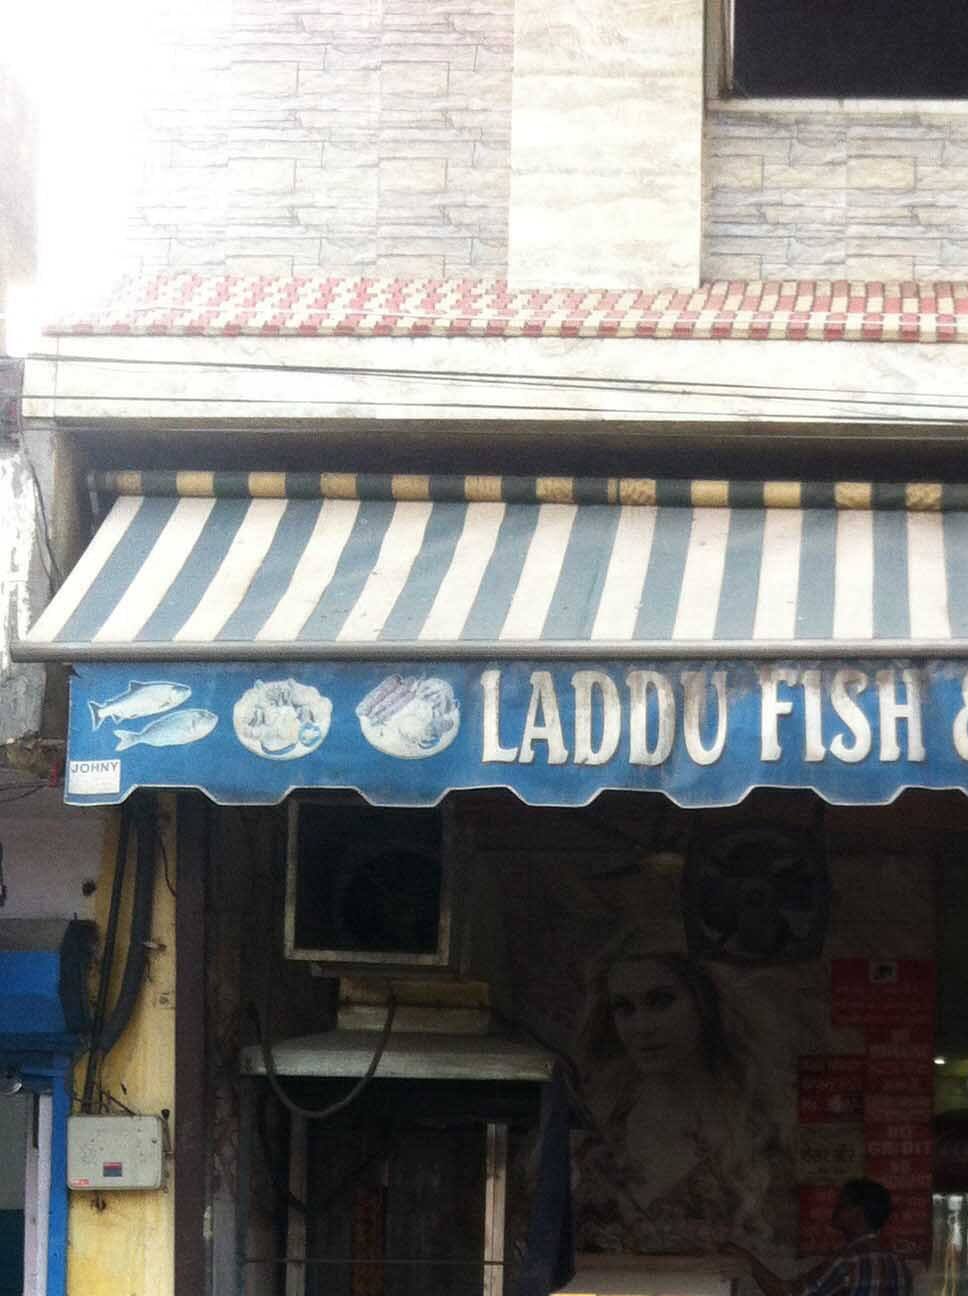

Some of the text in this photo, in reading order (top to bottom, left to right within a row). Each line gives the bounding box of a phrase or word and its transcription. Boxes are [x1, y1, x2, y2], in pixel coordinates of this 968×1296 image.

[480, 669, 727, 766] LADDU
[759, 669, 926, 762] FISH
[71, 762, 118, 773] JOHNY
